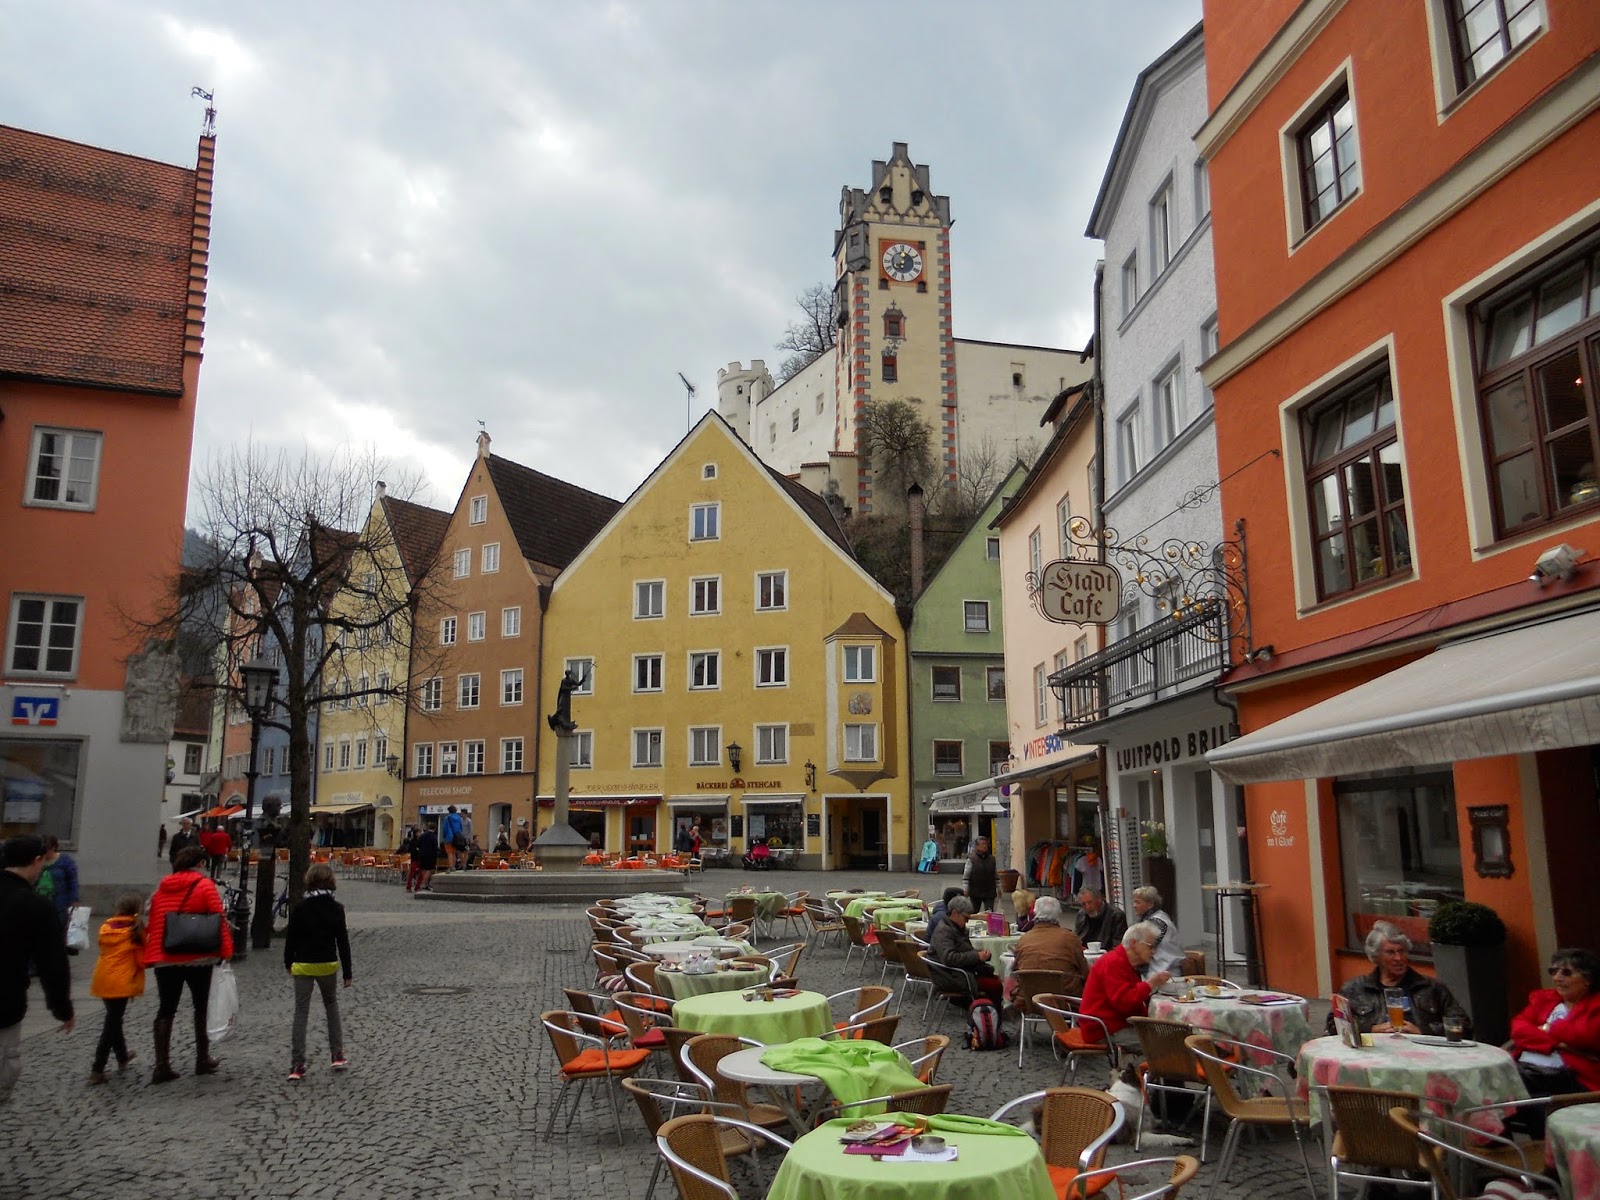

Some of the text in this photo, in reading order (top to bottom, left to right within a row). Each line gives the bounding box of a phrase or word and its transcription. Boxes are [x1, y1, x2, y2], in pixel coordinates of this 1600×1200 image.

[1047, 565, 1113, 592] Stadt
[1060, 592, 1103, 618] Cafe
[1116, 737, 1181, 772] LUITPOLD
[419, 785, 473, 796] TELECOM SHOP
[696, 781, 728, 790] BÄCKEREI
